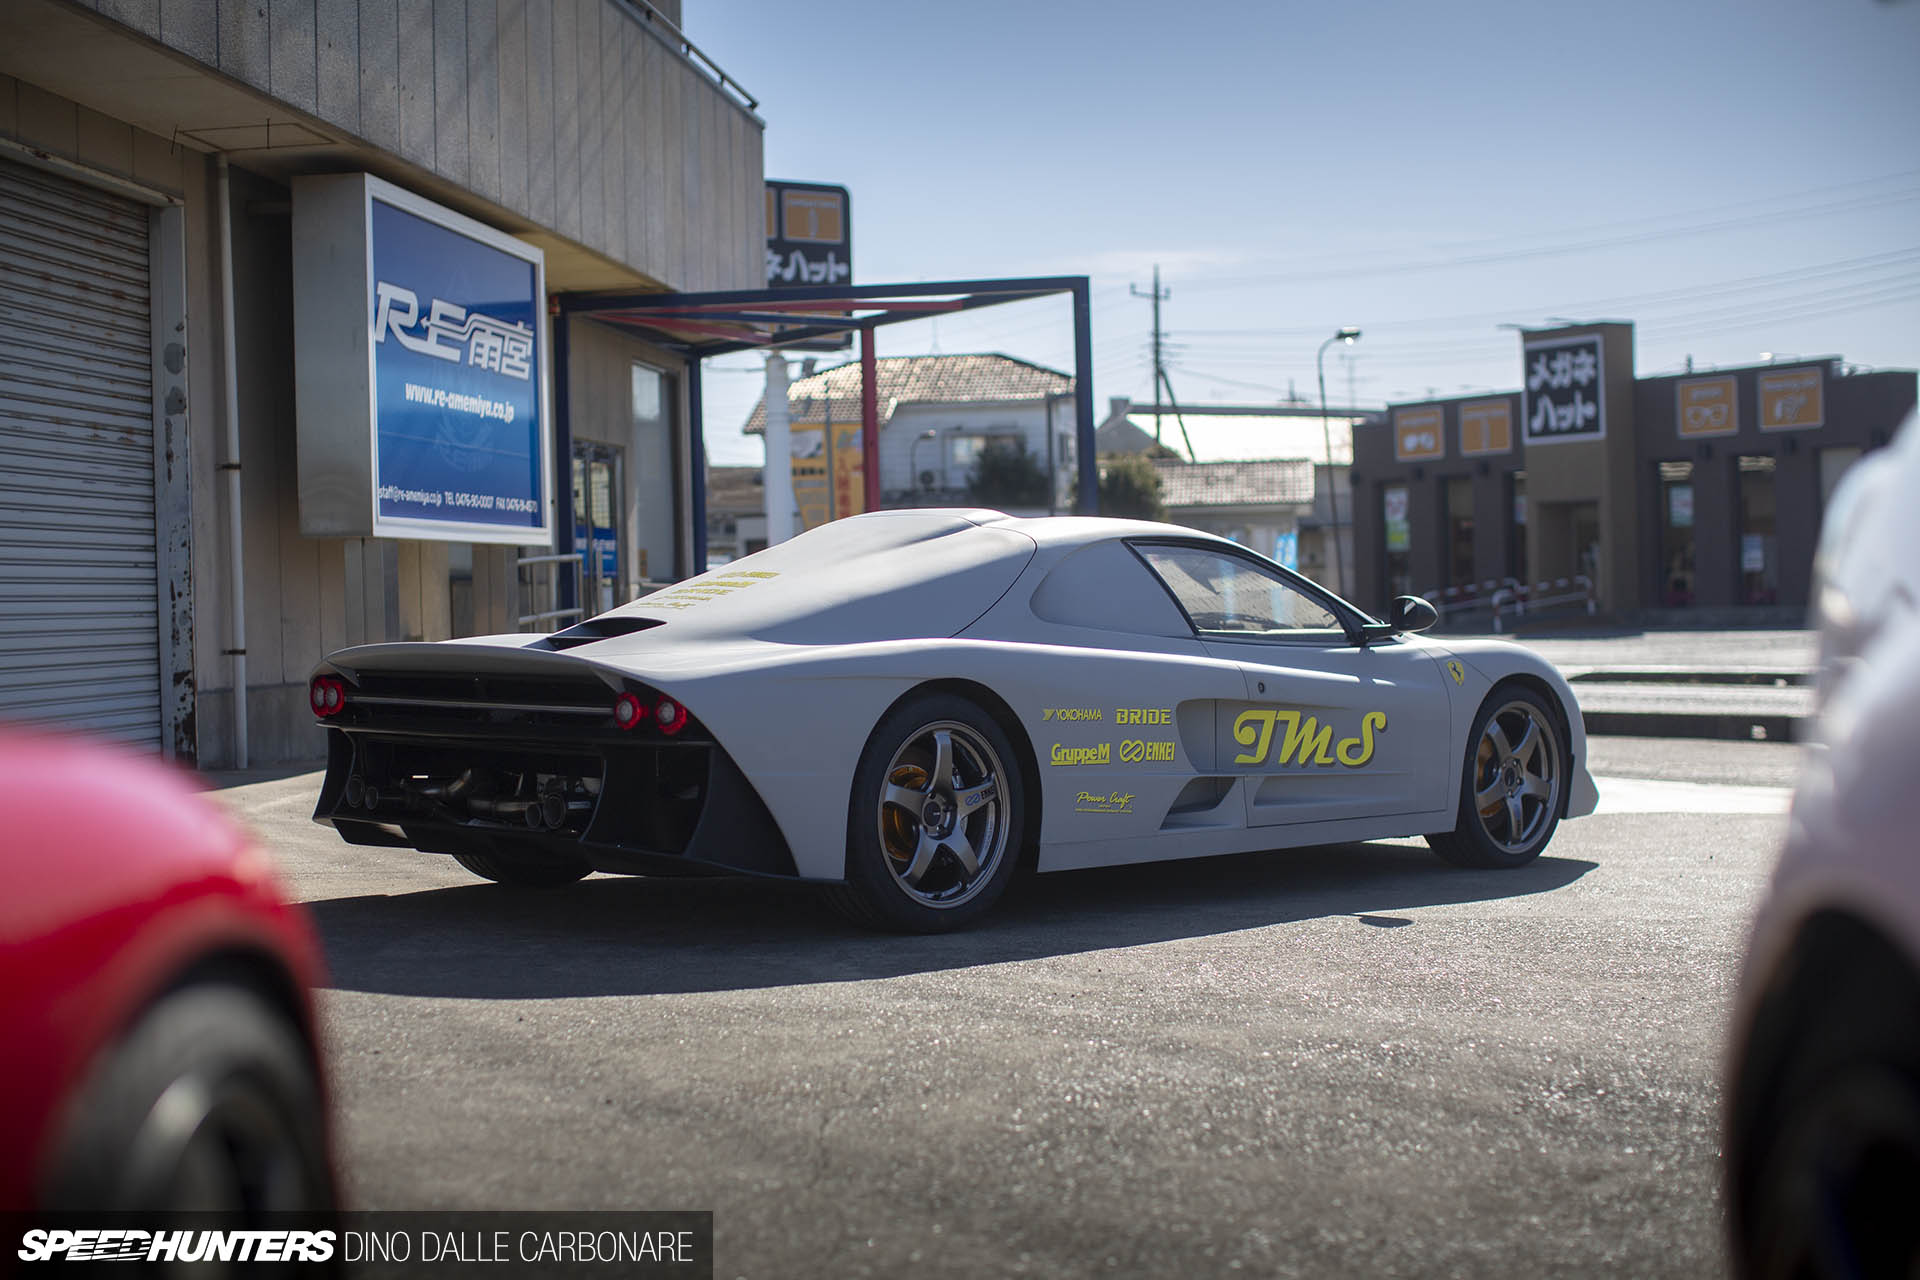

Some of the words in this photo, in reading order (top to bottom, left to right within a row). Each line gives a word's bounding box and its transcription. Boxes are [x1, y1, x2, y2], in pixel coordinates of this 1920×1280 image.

[1527, 348, 1596, 393] メガネ
[405, 383, 514, 423] www.re-amemiya.co.jp
[1531, 390, 1597, 433] ハット
[444, 491, 455, 505] TEL
[1055, 708, 1103, 721] YOKOHAMA
[1116, 708, 1172, 725] BRIDE
[1050, 743, 1111, 766] GruppeM
[1145, 741, 1176, 761] ENKEI
[1076, 791, 1107, 803] Power
